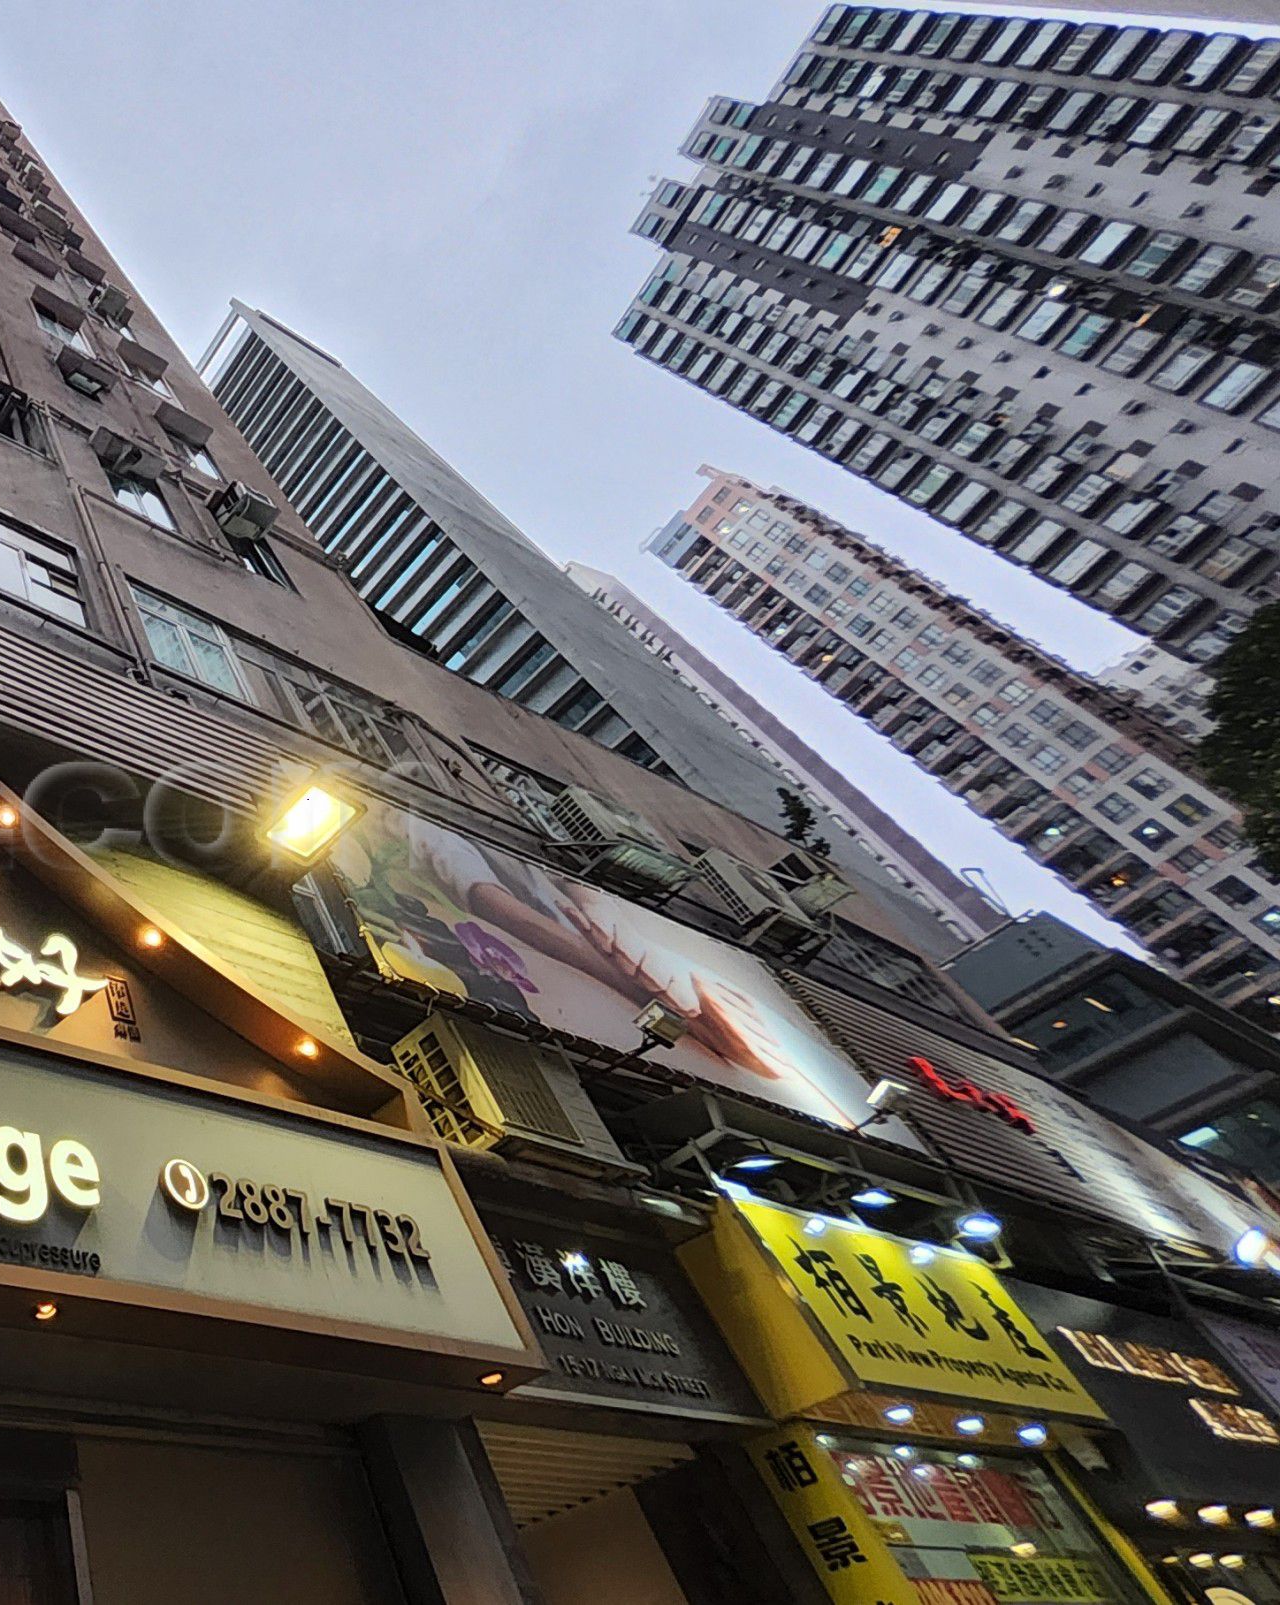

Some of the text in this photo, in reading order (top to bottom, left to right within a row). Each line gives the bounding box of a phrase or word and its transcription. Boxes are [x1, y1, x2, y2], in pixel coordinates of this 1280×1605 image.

[209, 1172, 431, 1259] 2887-7732
[535, 1305, 681, 1357] HON BUILDING
[846, 1334, 896, 1361] Park
[885, 1341, 936, 1368] View
[926, 1349, 1004, 1384] Property
